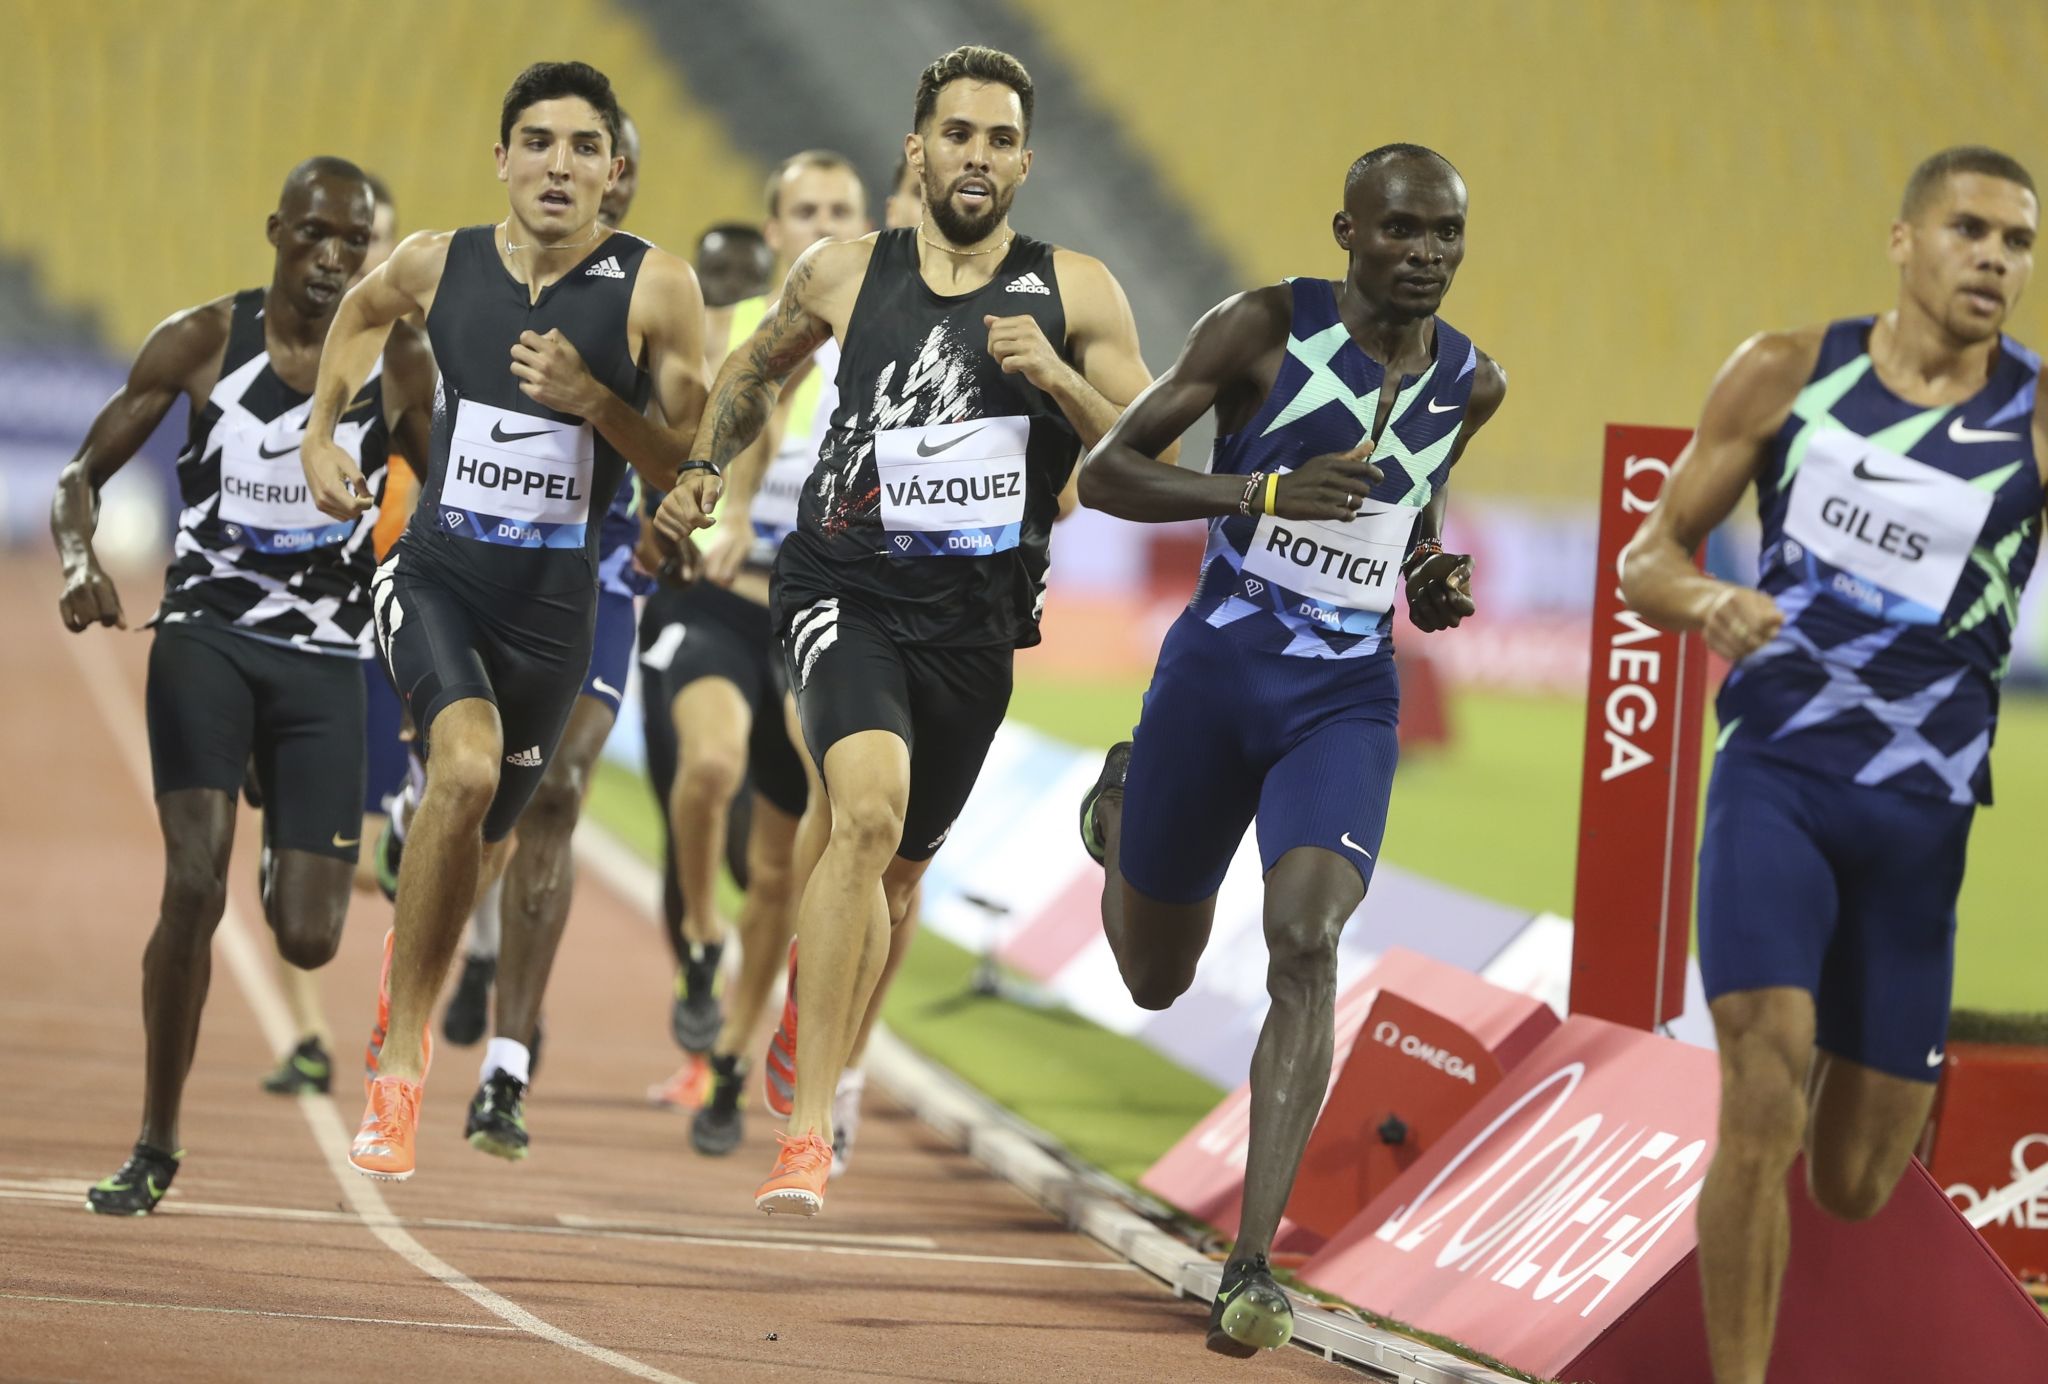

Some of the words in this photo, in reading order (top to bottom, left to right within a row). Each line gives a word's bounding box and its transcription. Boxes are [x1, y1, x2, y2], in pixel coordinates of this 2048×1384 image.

[1005, 284, 1051, 296] adidas
[224, 476, 307, 504] CHERUI
[456, 455, 582, 501] HOPPEL
[886, 471, 1021, 507] VÁZQUEZ
[497, 524, 542, 541] DOHA
[948, 534, 994, 549] DOHA
[1821, 496, 1930, 564] GILES
[1266, 525, 1389, 588] ROTICH
[1299, 602, 1341, 625] DOHA
[1601, 543, 1663, 782] MEGA
[1400, 1034, 1476, 1085] OMEGA
[1434, 1112, 1707, 1319] OMEGA
